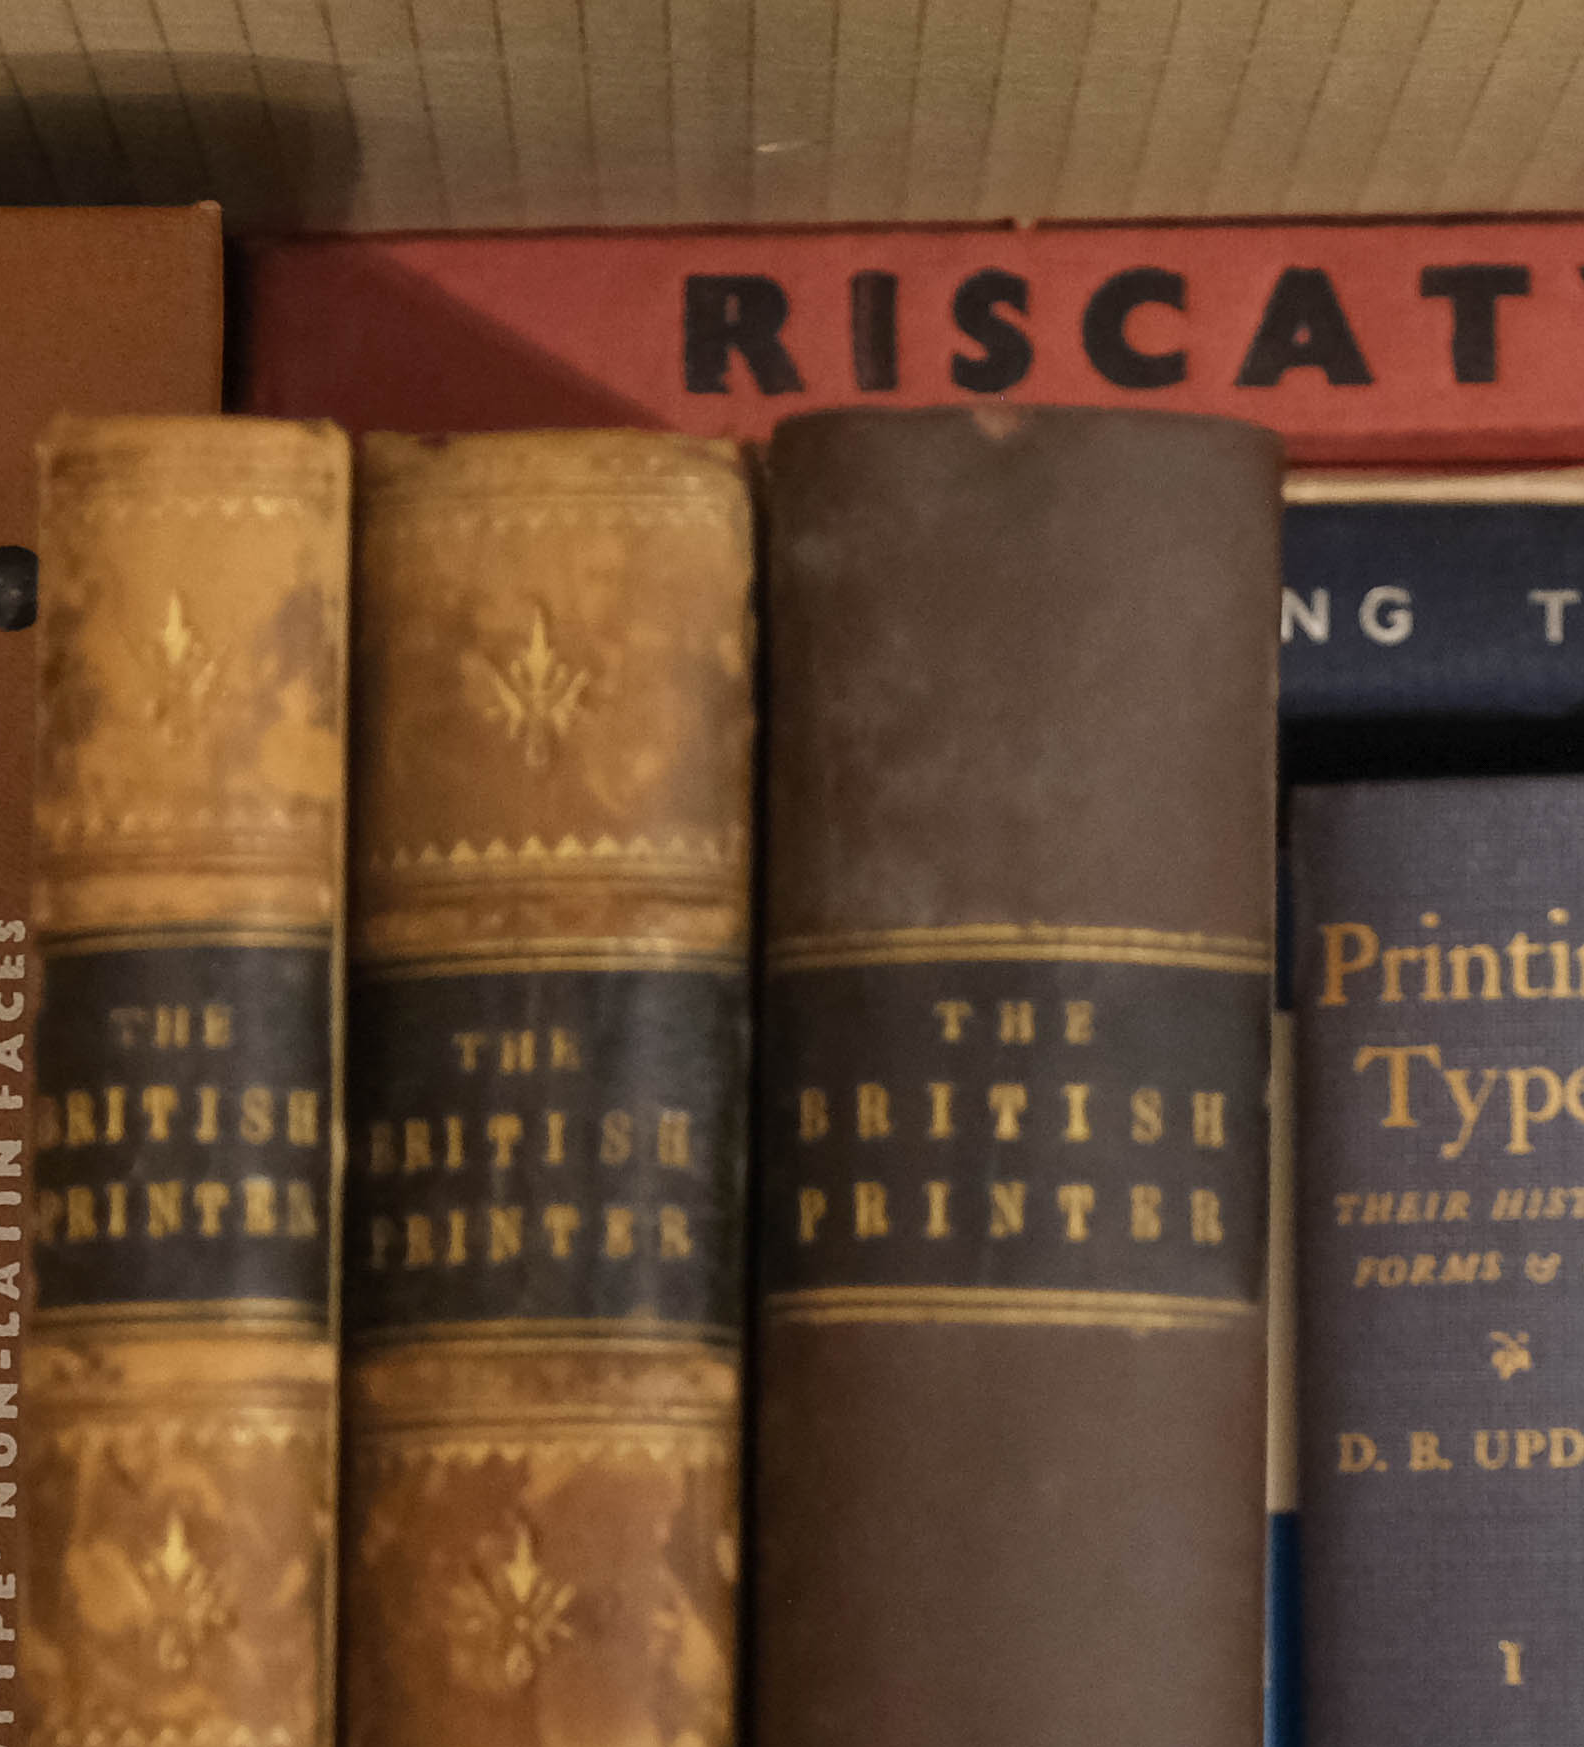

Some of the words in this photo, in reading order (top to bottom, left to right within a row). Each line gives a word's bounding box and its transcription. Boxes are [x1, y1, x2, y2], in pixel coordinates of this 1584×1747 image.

[934, 1000, 1095, 1045] THE
[798, 1081, 1226, 1149] BRITISH
[798, 1179, 1226, 1245] PRINTER
[1334, 1188, 1472, 1226] THEIR
[1353, 1249, 1504, 1288] FORMS
[1337, 1431, 1388, 1473] D.
[1408, 1430, 1453, 1473] B.
